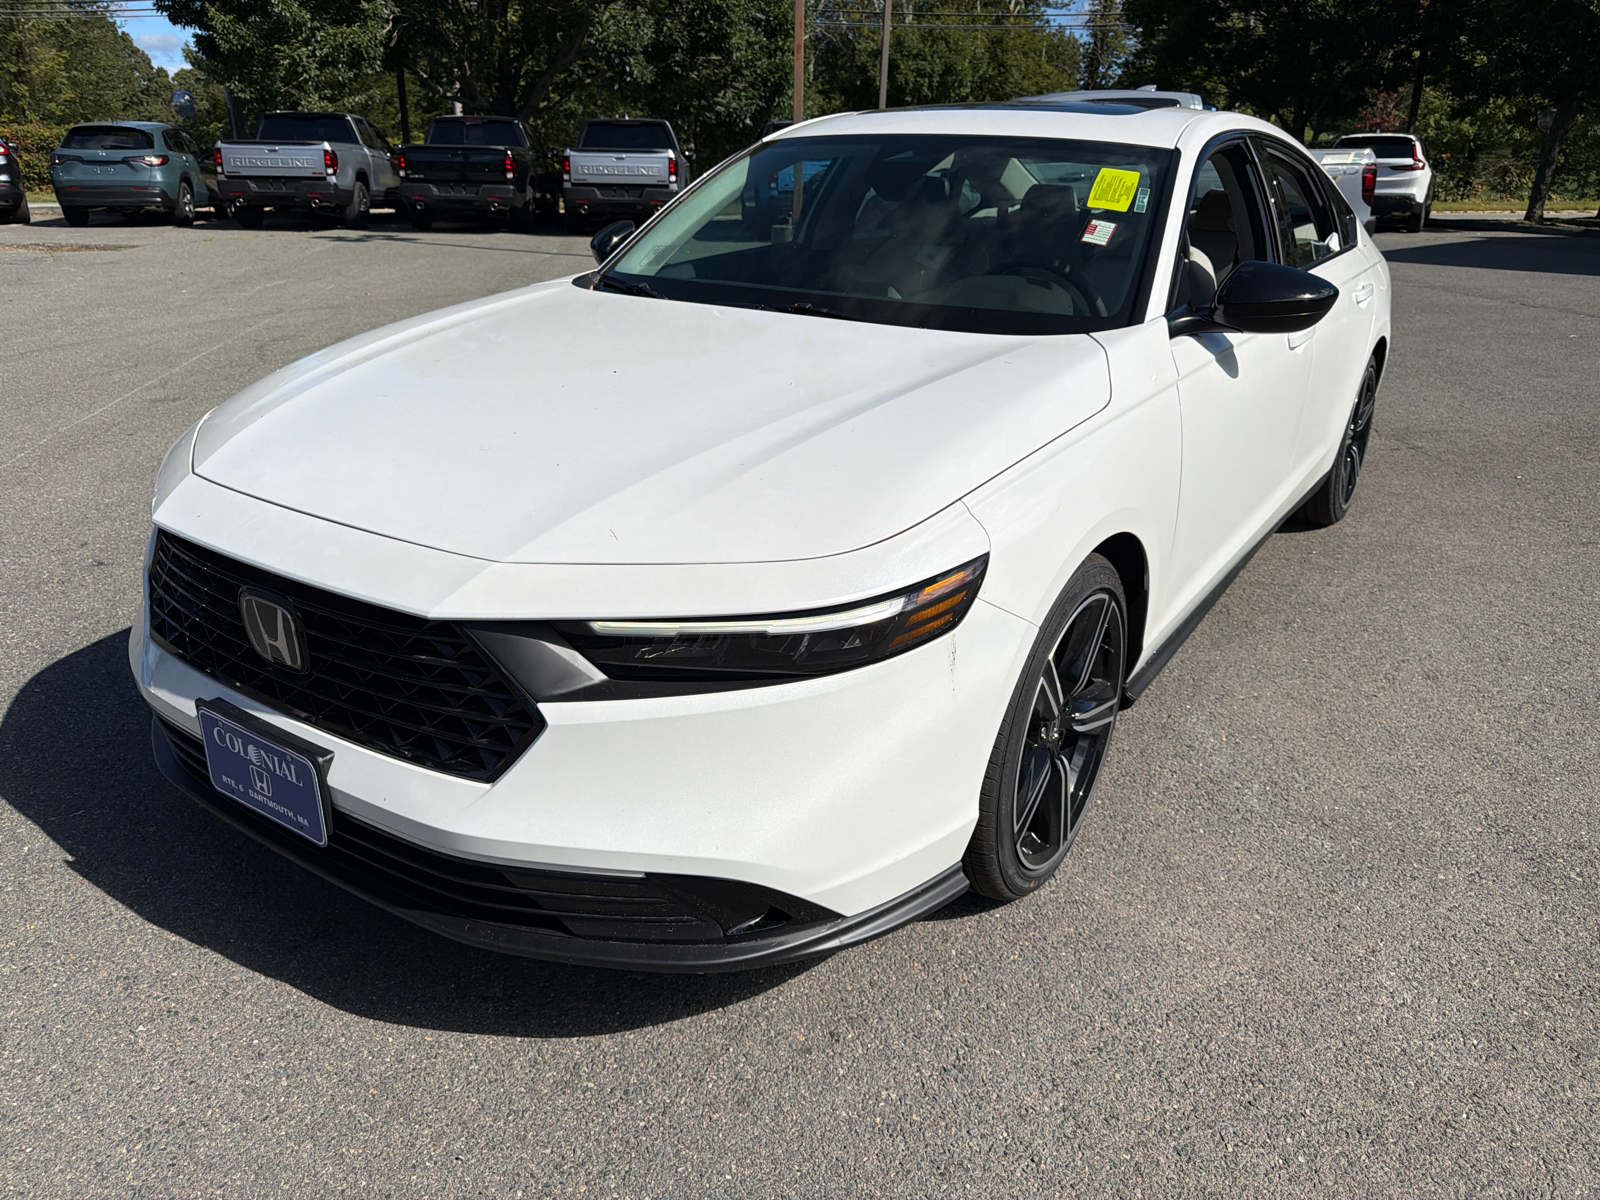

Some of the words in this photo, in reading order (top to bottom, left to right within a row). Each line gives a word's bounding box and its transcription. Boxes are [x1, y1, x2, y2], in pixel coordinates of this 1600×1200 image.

[230, 157, 315, 167] RIDGELINE
[578, 165, 660, 175] RIDGELINE
[213, 726, 303, 786] COLONIAL
[222, 775, 238, 790] RTE.
[238, 784, 244, 792] 6
[248, 789, 297, 821] DARTMOUTH,
[296, 814, 310, 827] MA
